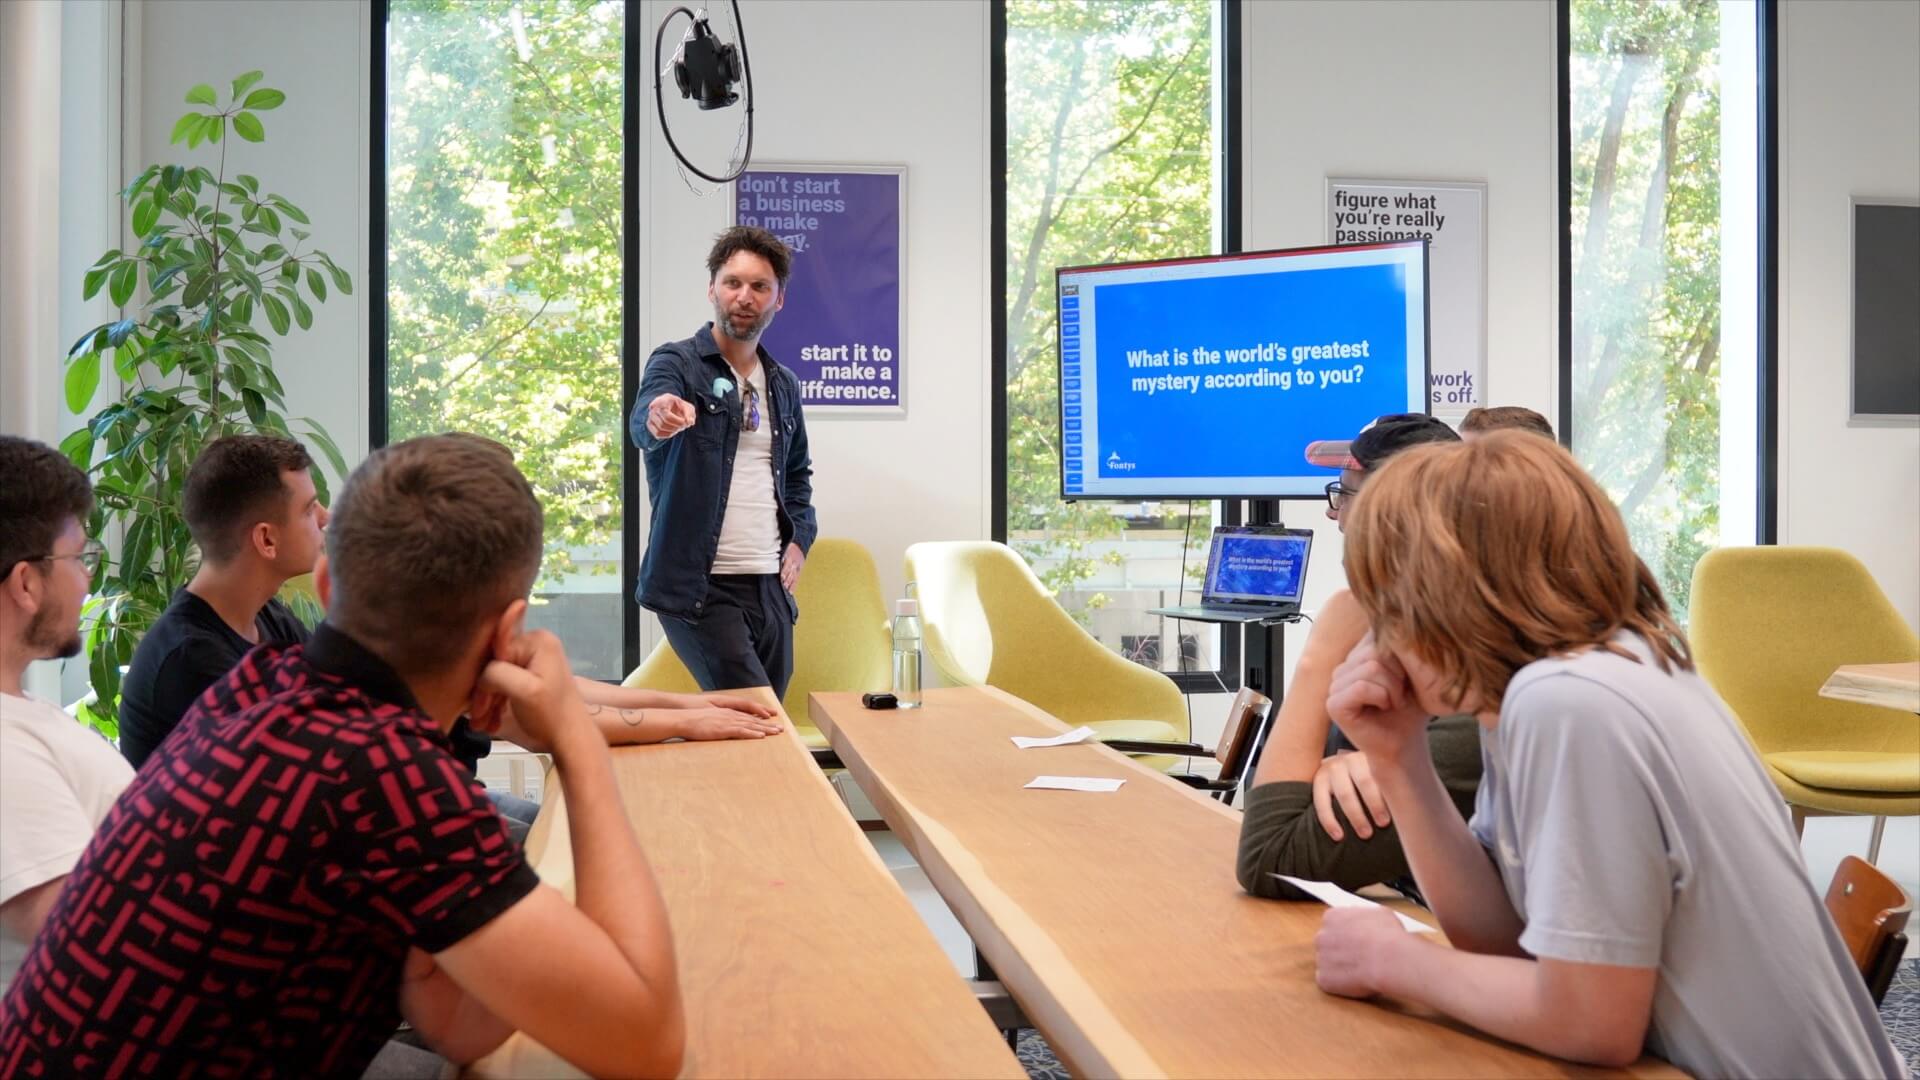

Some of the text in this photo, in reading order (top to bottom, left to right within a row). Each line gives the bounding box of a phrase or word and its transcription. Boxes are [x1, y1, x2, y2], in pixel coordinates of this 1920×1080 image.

[740, 175, 841, 194] don't start
[740, 193, 845, 213] a business
[1335, 190, 1437, 211] figure what
[740, 212, 819, 230] to make
[1335, 209, 1446, 231] you're really
[1336, 227, 1433, 244] passionate
[801, 343, 892, 361] start it to
[1127, 340, 1370, 368] What is the world's greatest
[821, 362, 892, 380] make a
[1132, 364, 1364, 395] mystery according to you?
[1430, 370, 1473, 386] work
[1447, 387, 1477, 403] off.
